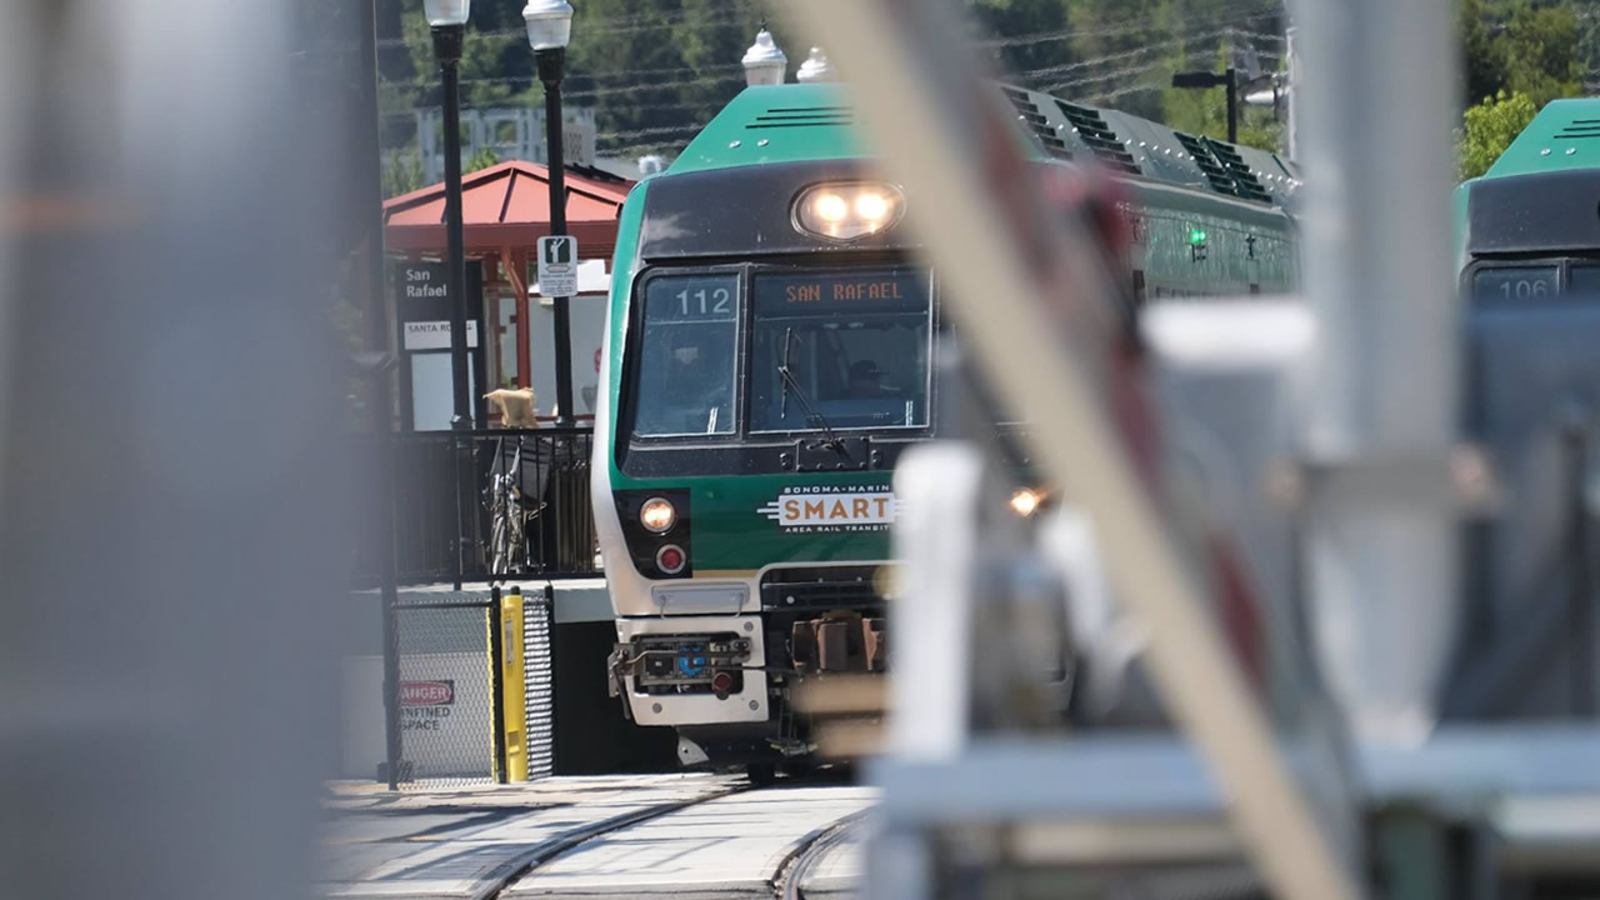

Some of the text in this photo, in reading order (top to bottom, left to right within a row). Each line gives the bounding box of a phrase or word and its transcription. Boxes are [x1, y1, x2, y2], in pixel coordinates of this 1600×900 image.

[405, 269, 430, 281] San
[406, 283, 447, 298] Rafael
[786, 282, 903, 302] SAN RAFAEL
[1500, 280, 1548, 300] 106
[677, 288, 730, 315] 112
[408, 324, 438, 333] SANTA
[784, 485, 890, 494] SONOMA-MARIN
[784, 498, 890, 520] SMART
[400, 687, 447, 699] ANGER
[402, 720, 440, 731] SPACE
